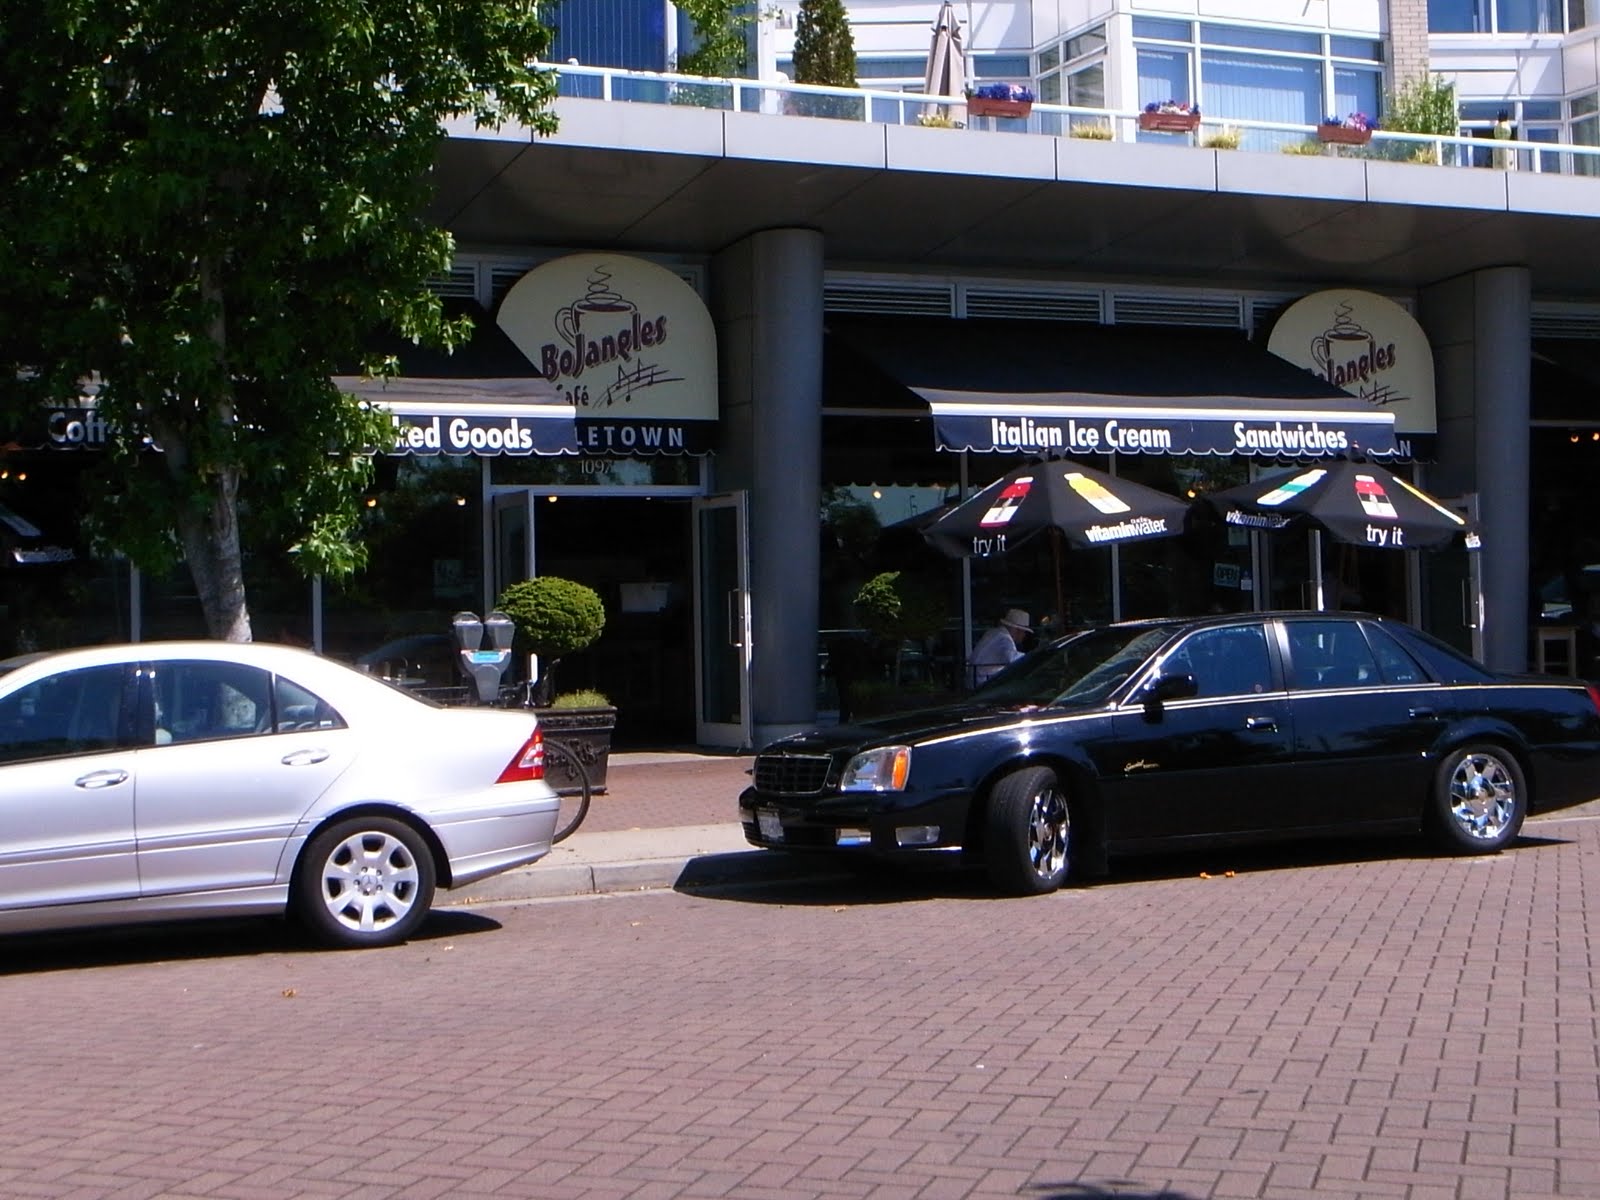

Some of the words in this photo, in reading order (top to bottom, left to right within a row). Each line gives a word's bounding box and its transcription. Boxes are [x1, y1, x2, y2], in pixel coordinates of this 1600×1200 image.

[1306, 343, 1396, 387] Jangles
[557, 384, 589, 406] afé
[450, 418, 533, 449] Goods
[991, 417, 1062, 447] Italian
[1068, 419, 1099, 447] Ice
[1105, 420, 1171, 448] Cream
[1234, 421, 1348, 449] Sandwiches
[973, 536, 993, 557] try
[997, 534, 1006, 551] it
[1366, 524, 1388, 546] try
[1392, 526, 1403, 545] it
